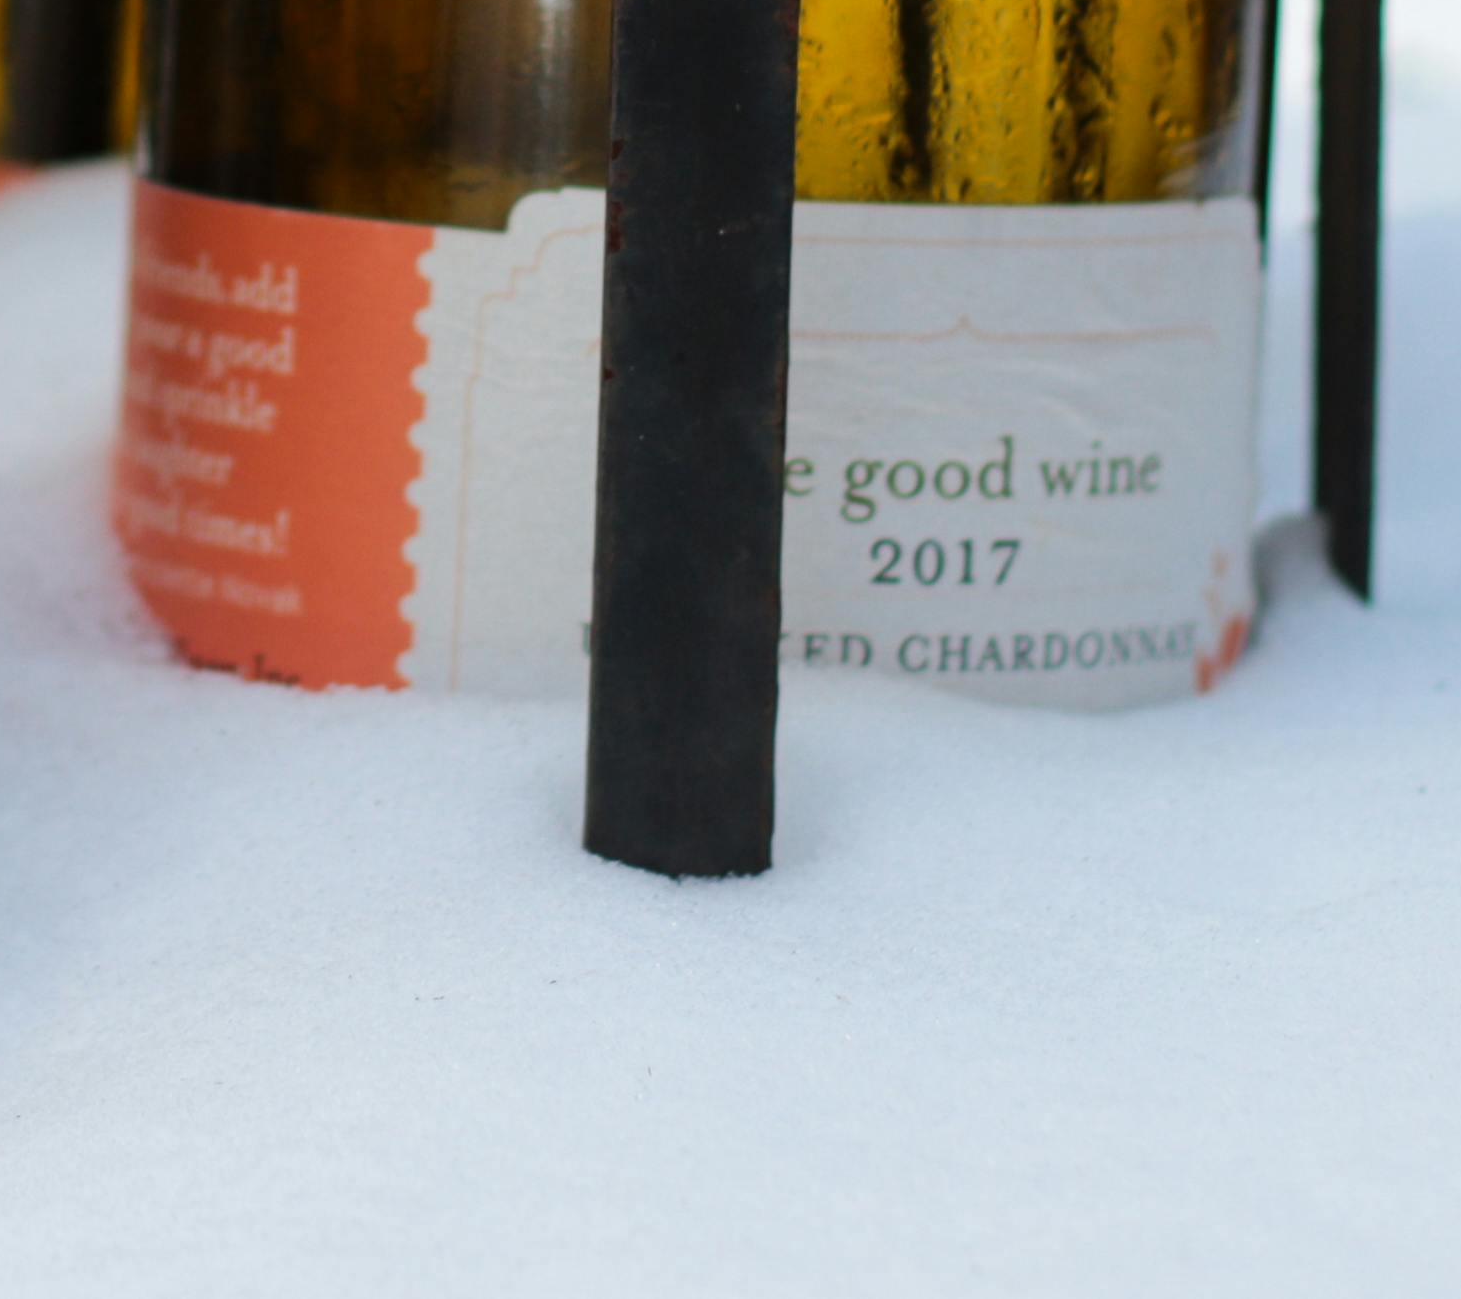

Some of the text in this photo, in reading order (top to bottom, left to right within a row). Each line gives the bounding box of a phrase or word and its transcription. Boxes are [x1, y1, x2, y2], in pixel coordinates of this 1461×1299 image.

[840, 435, 1014, 523] good
[1040, 439, 1163, 498] wine
[869, 538, 1022, 586] 2017
